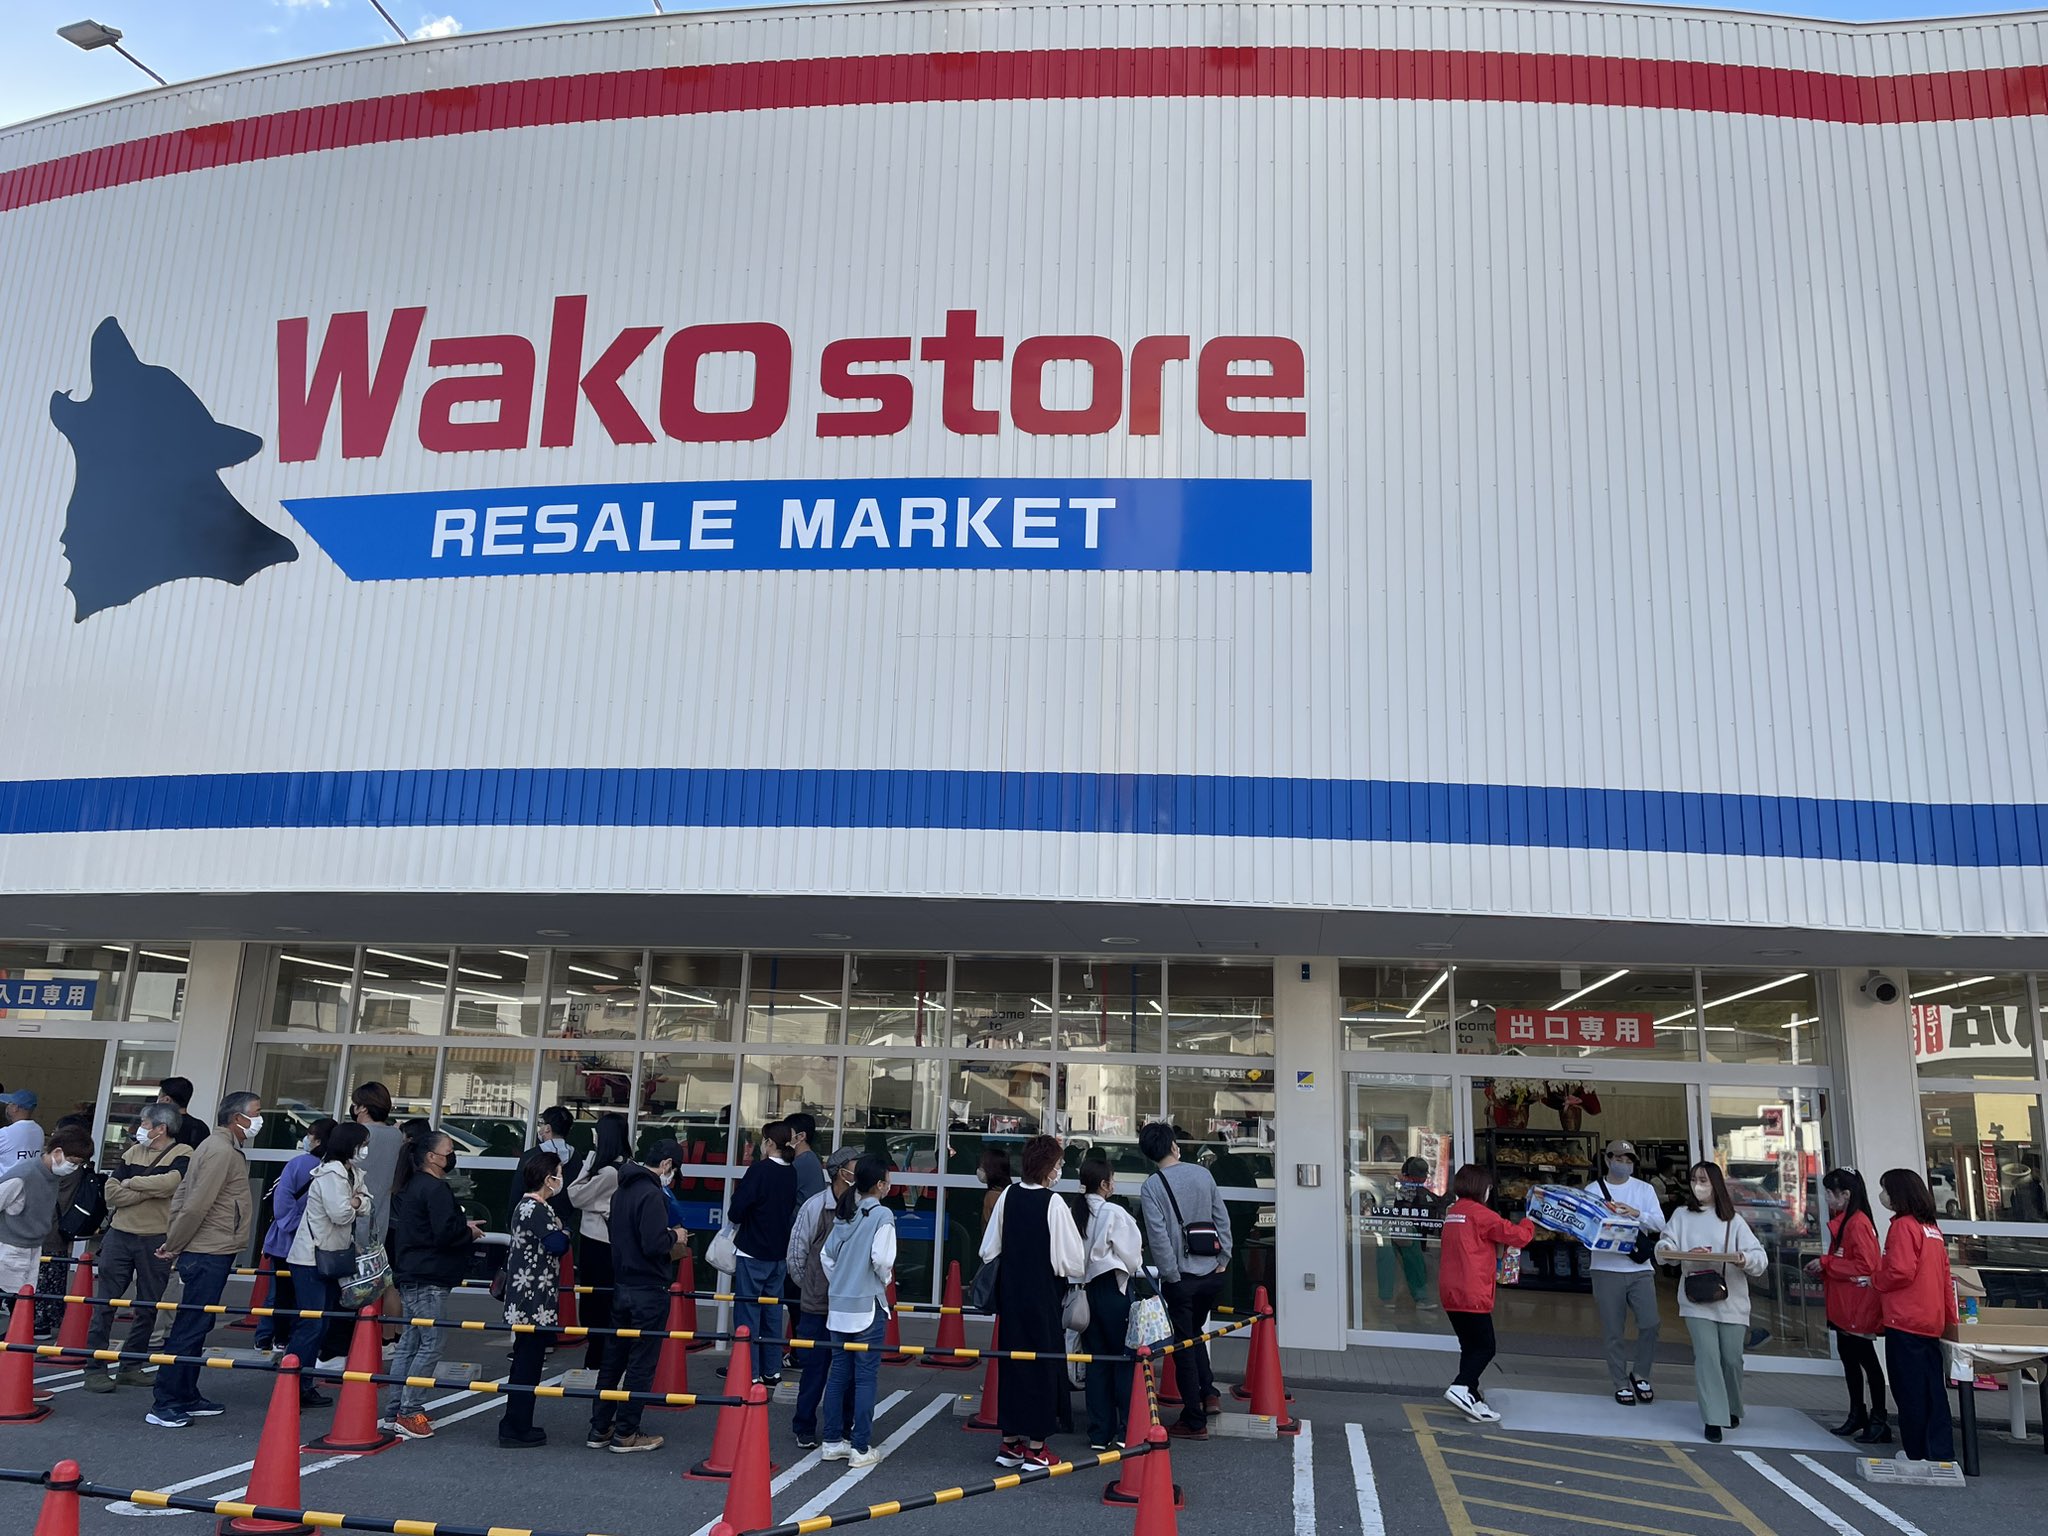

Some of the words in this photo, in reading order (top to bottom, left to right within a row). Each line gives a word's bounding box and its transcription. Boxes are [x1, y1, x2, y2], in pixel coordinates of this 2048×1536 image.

[276, 294, 792, 463] Wako
[815, 309, 1308, 438] store
[431, 498, 737, 560] RESALE
[778, 495, 1118, 551] MARKET
[0, 983, 87, 1007] 入口専用
[1457, 1033, 1474, 1044] to
[1509, 1014, 1640, 1043] 出口専用
[1541, 1201, 1564, 1222] Bath
